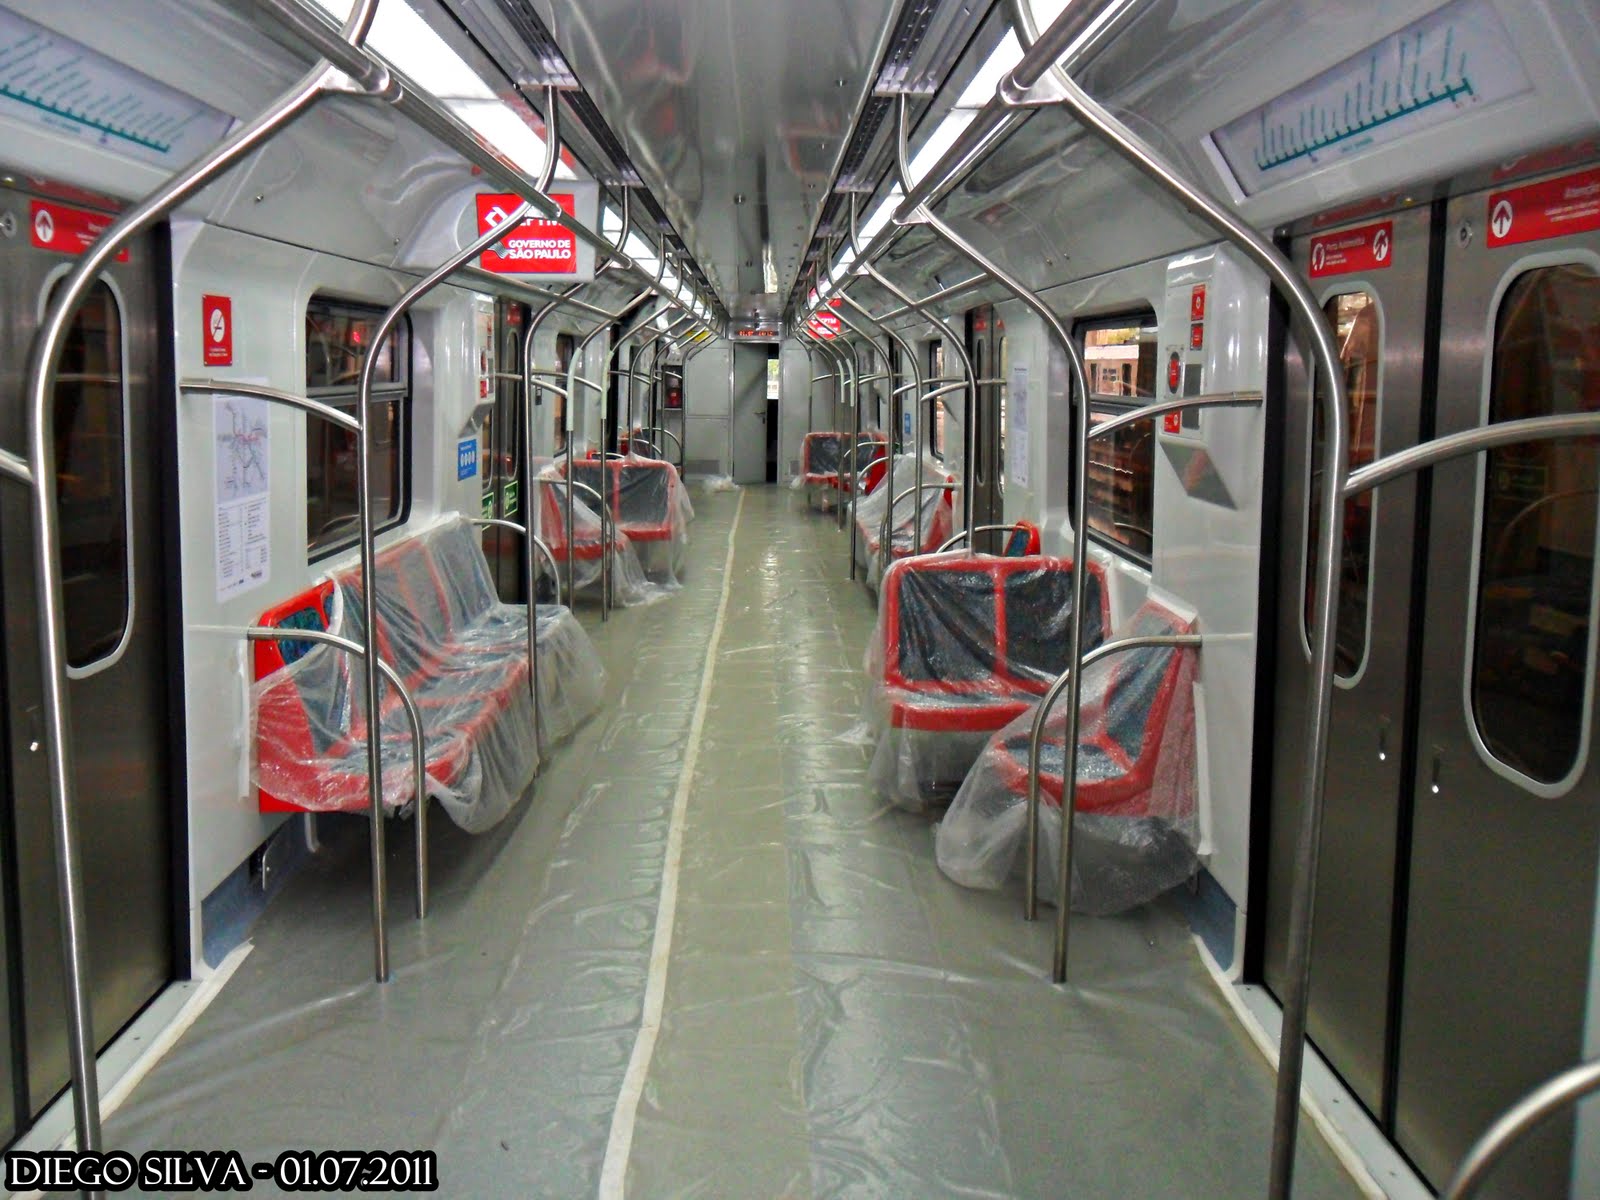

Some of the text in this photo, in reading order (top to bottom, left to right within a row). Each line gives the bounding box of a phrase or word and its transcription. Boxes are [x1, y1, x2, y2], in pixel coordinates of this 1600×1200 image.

[508, 239, 571, 249] GOVERNO DE
[508, 247, 571, 259] SÃO PAULO
